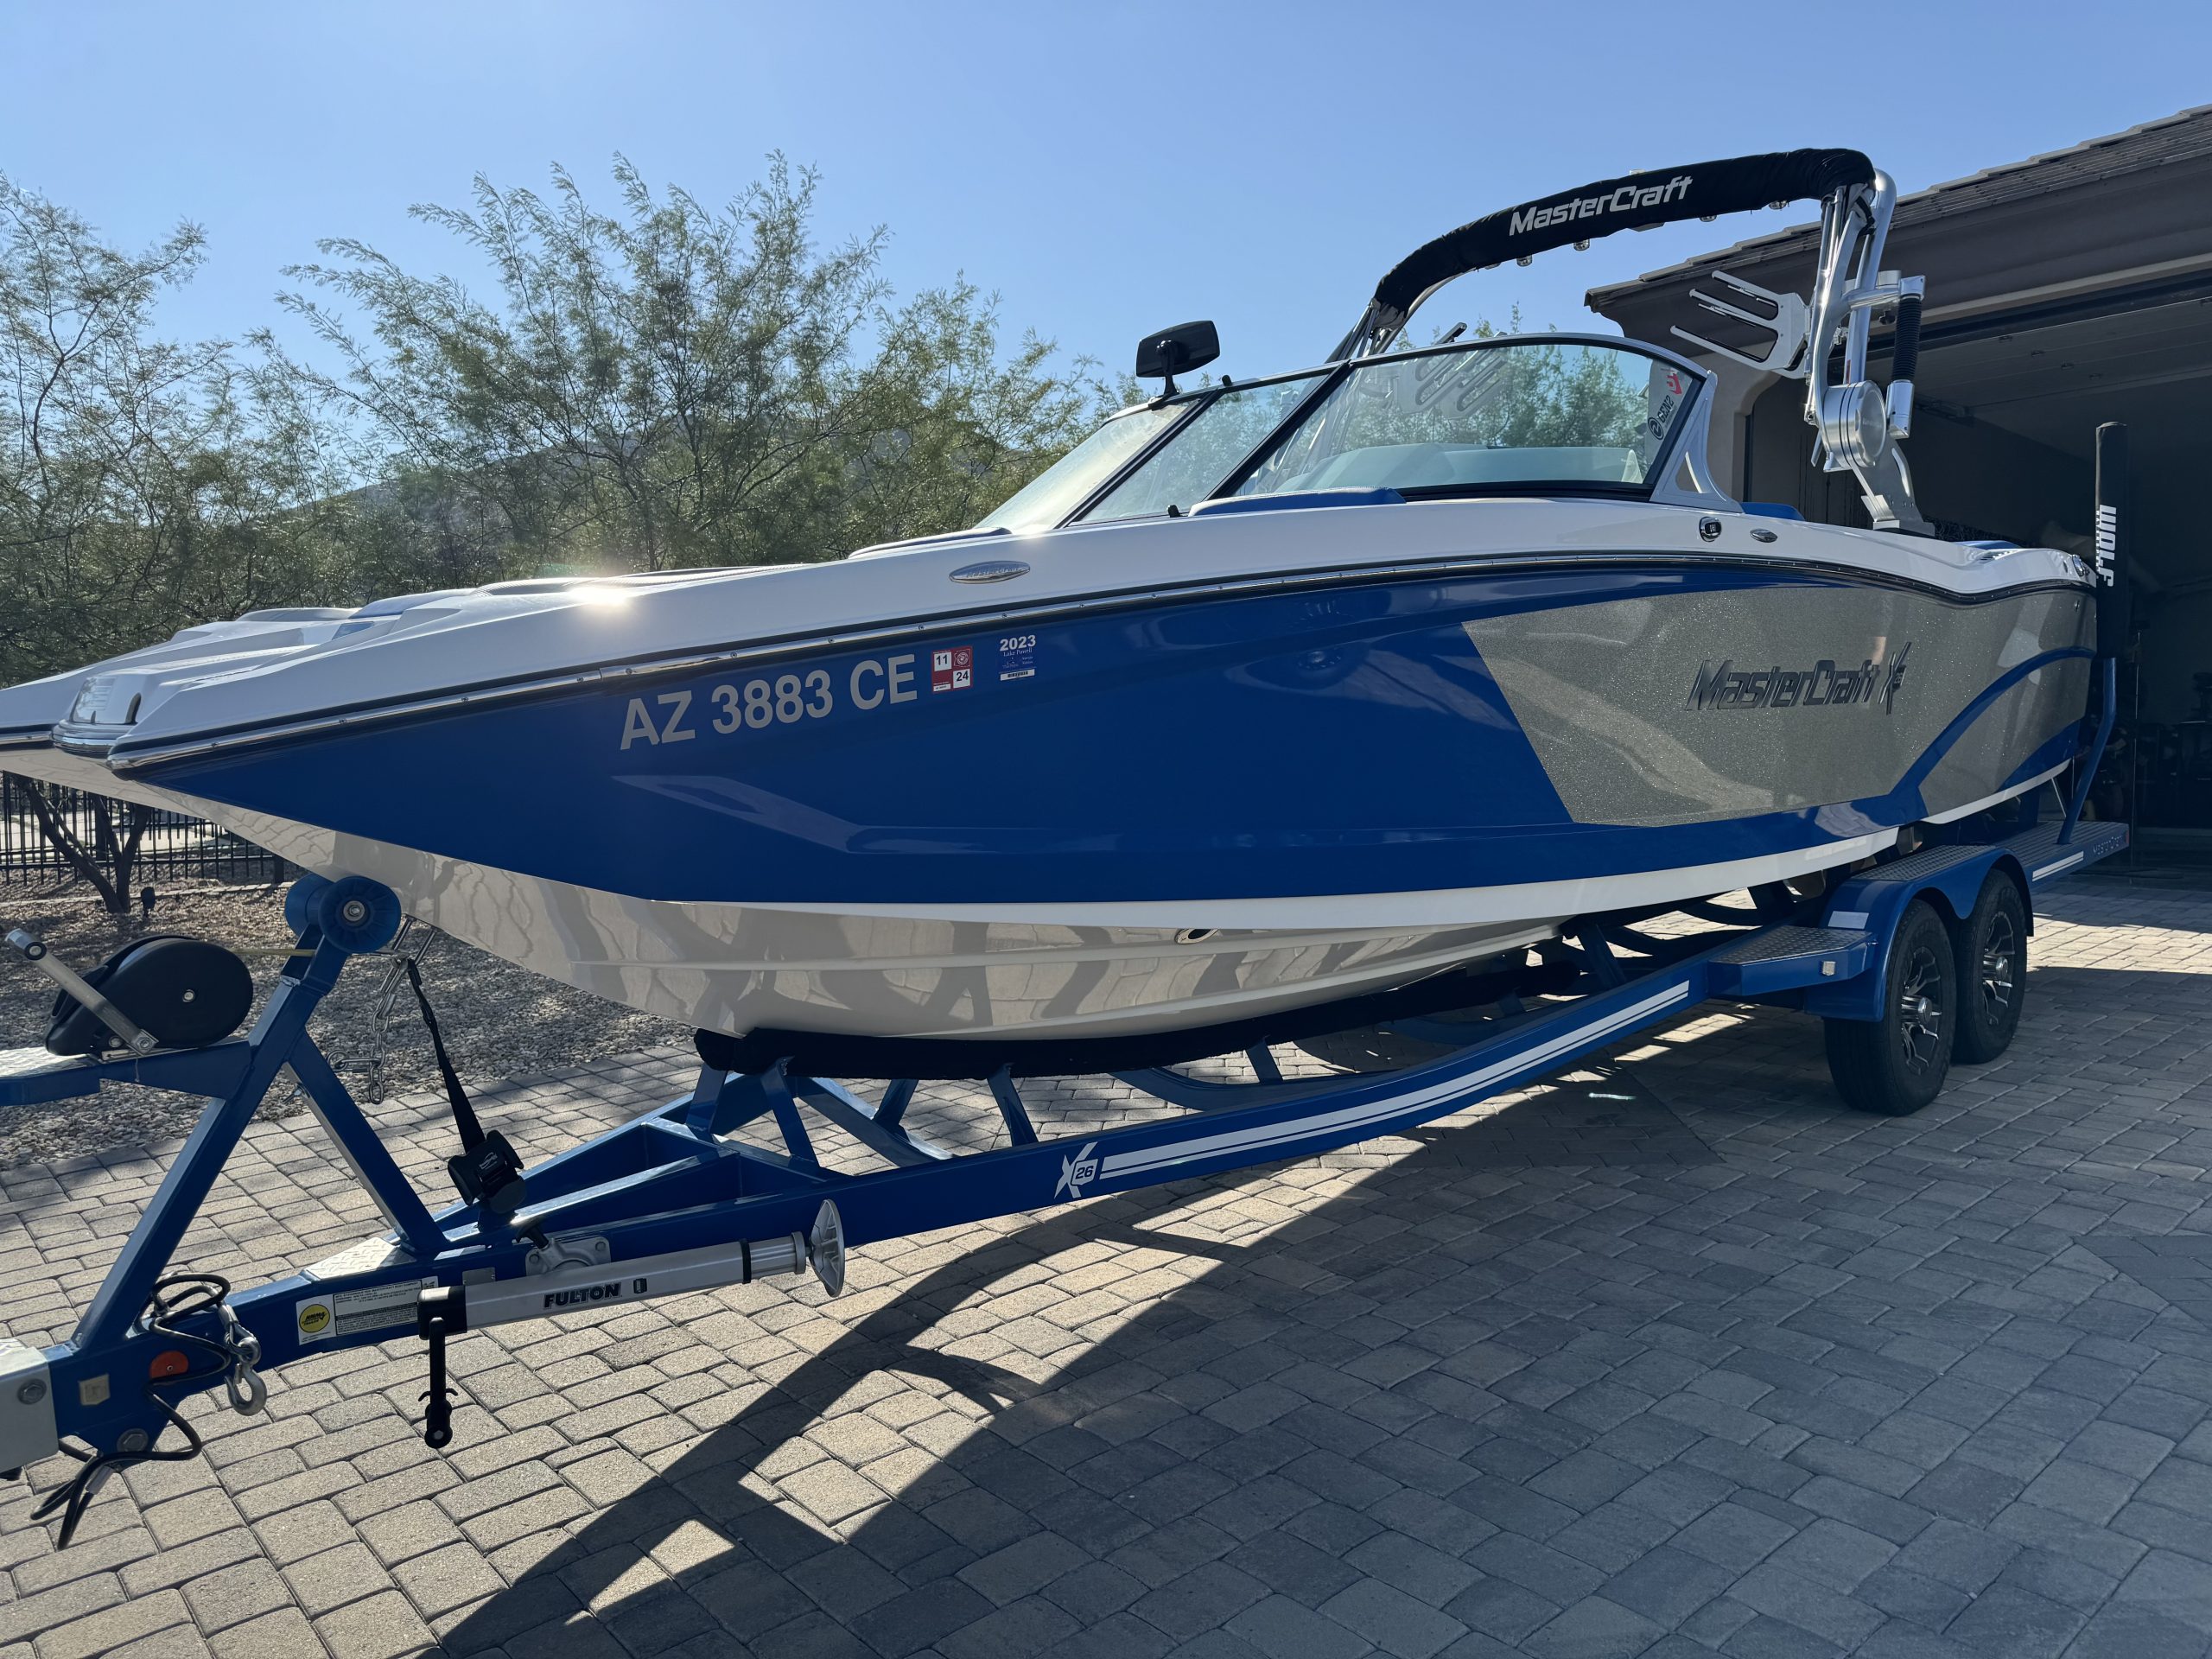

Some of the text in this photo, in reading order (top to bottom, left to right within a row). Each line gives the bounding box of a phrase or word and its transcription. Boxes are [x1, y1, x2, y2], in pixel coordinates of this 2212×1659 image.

[1509, 175, 1693, 236] MasterCraft
[2099, 505, 2117, 587] WOLF
[936, 654, 948, 665] 11
[1000, 634, 1036, 652] 2023
[956, 671, 969, 682] 24
[1685, 659, 1880, 711] MasterCraft
[620, 654, 918, 750] AZ 3883 CE
[543, 1282, 621, 1309] FULTON
